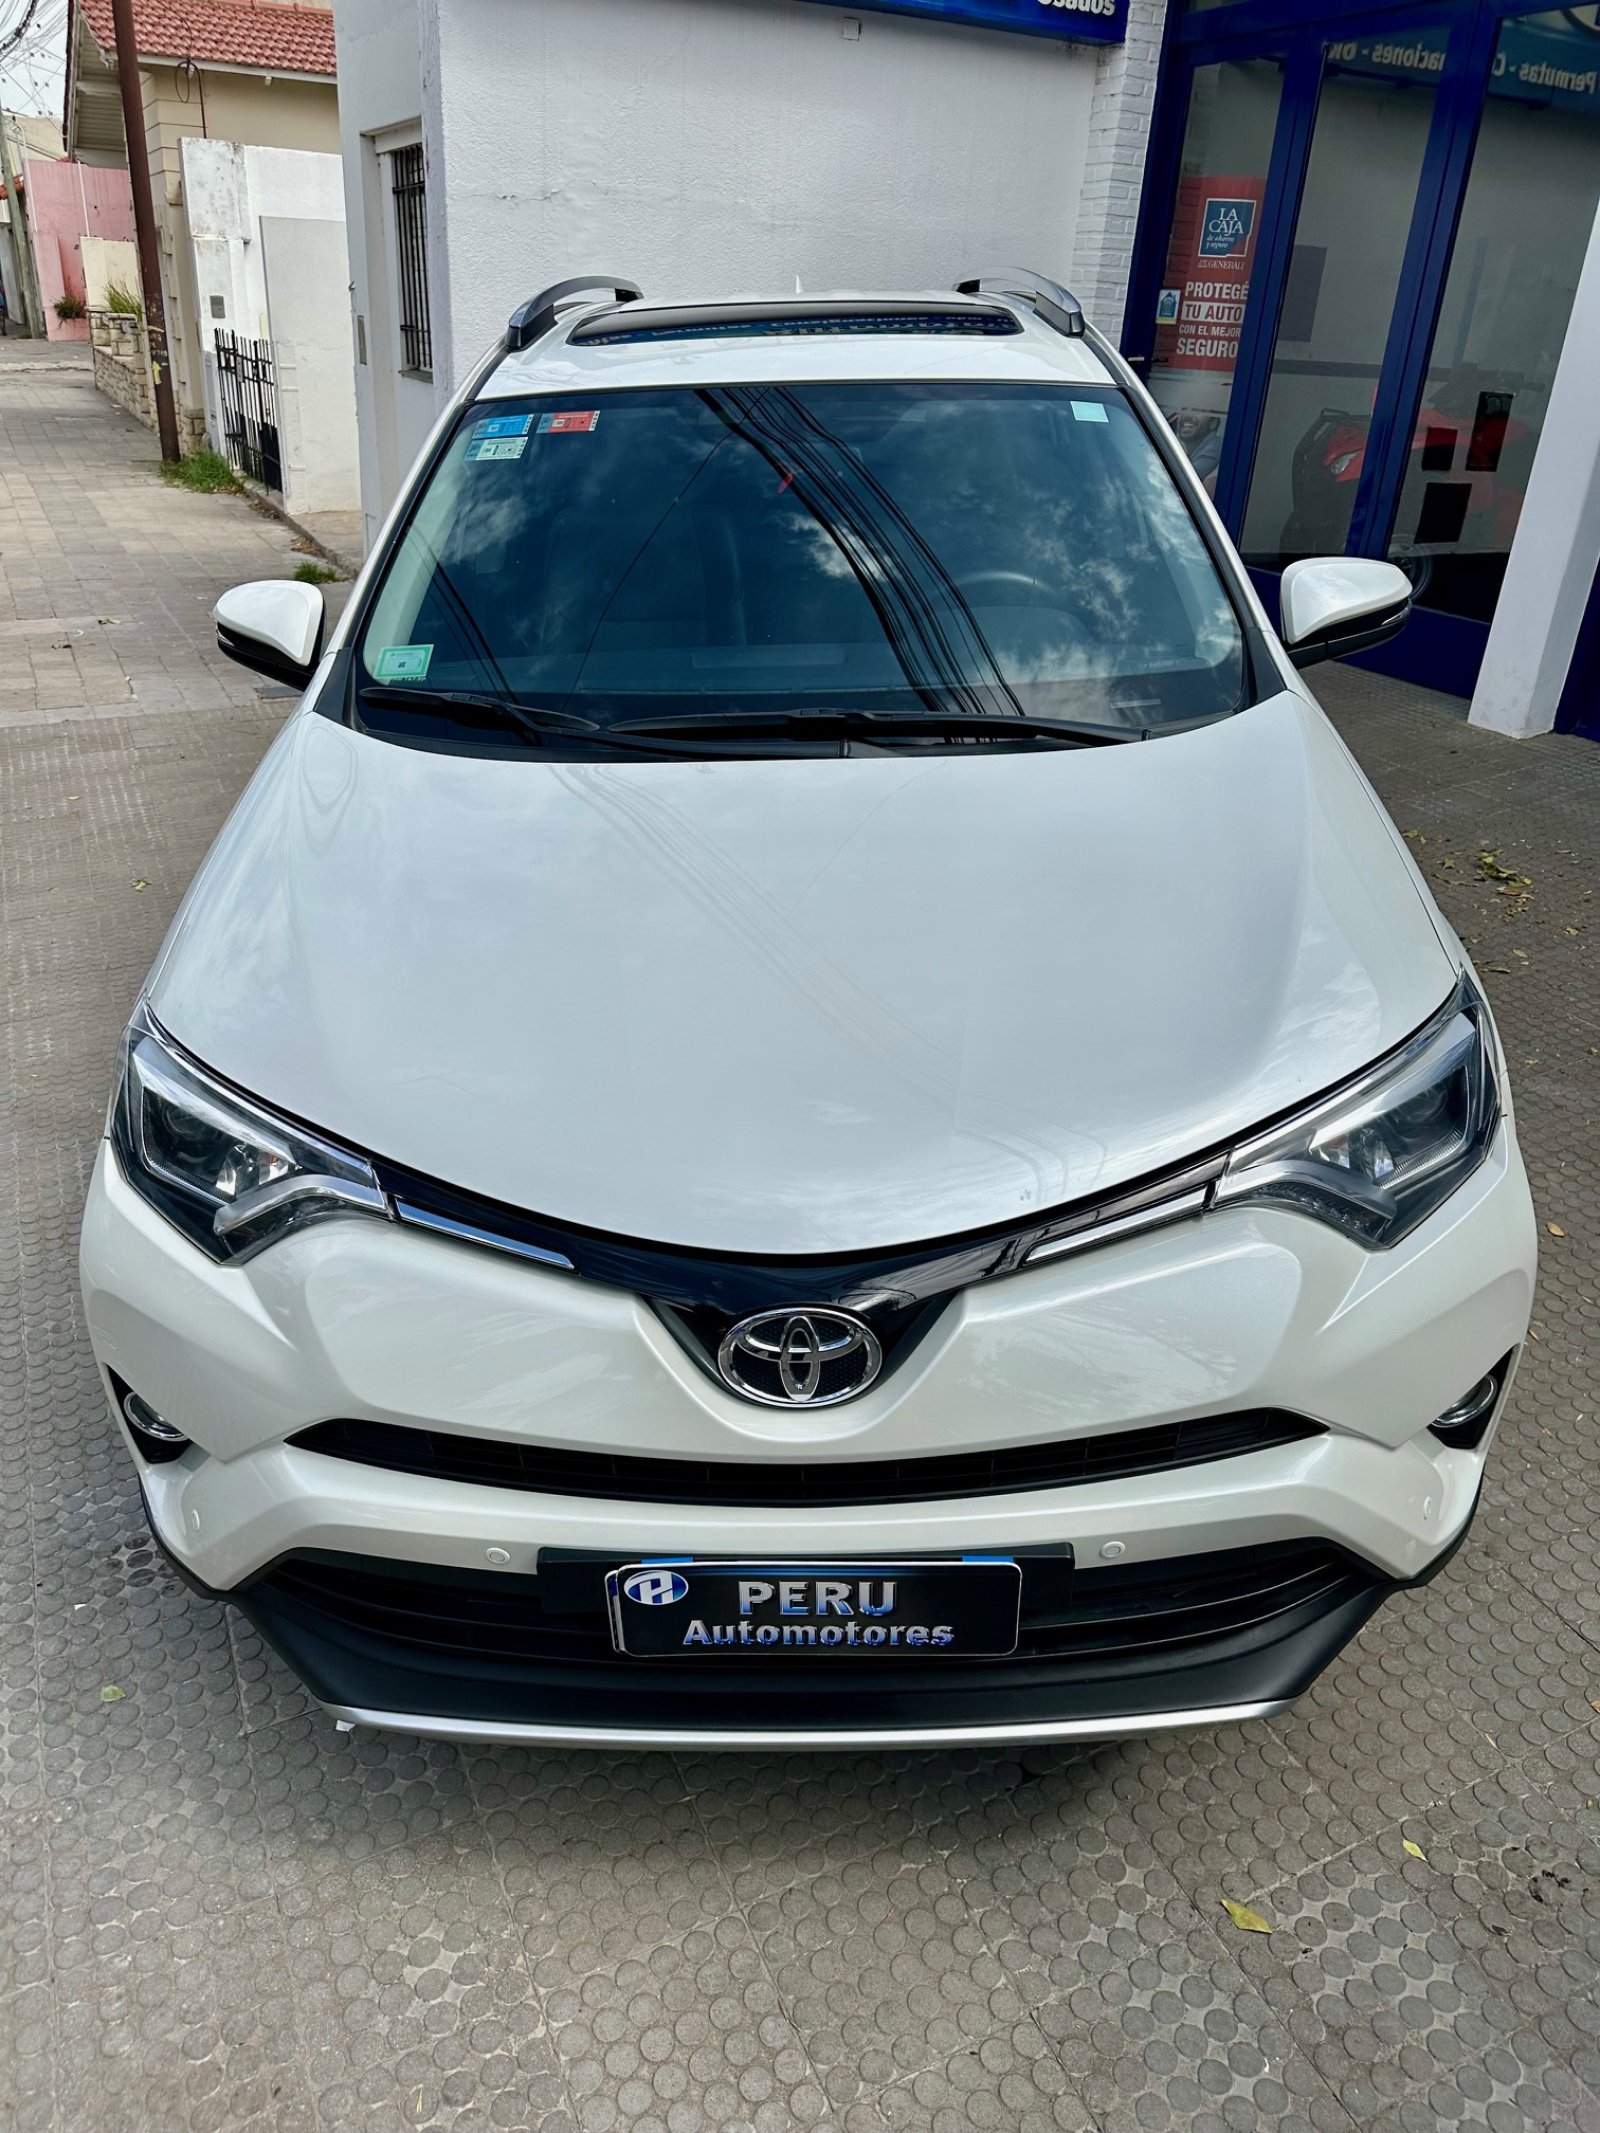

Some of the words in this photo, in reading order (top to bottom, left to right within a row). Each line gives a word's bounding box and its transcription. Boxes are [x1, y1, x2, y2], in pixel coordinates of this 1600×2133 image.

[1038, 0, 1115, 16] ados
[1219, 208, 1238, 220] LA
[1209, 220, 1243, 236] CAJA
[1208, 260, 1244, 270] GENERALI
[1185, 281, 1249, 300] PROTEGÉ
[1185, 304, 1201, 319] TU
[1205, 305, 1242, 322] AUTO
[1179, 324, 1195, 334] CON
[1198, 325, 1208, 335] EL
[1211, 326, 1240, 338] MEJOR
[1176, 338, 1239, 358] SEGURO
[738, 1580, 898, 1617] PERU
[682, 1619, 954, 1647] Automotores
